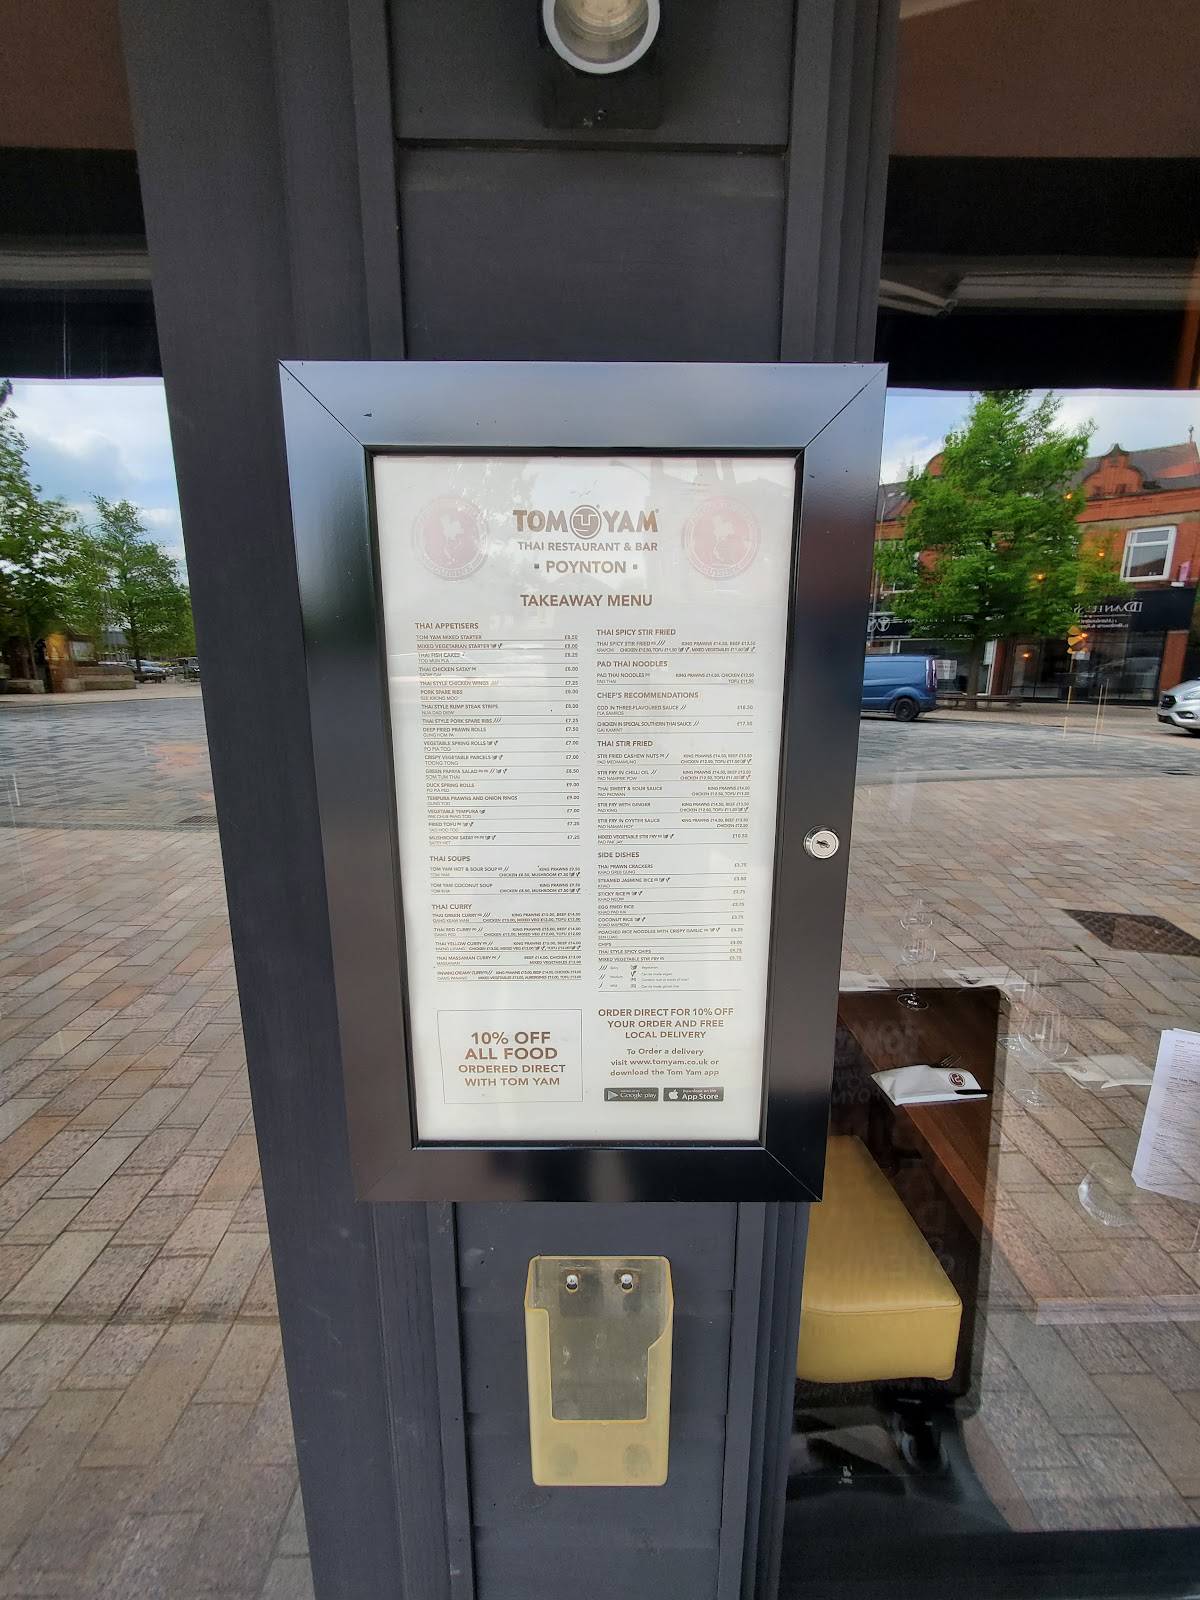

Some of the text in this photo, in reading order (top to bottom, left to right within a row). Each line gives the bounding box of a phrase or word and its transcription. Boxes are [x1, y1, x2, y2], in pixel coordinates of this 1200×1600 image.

[512, 510, 658, 534] TOM YAM
[518, 541, 658, 552] THAI RESTAURANT & BAR
[546, 561, 626, 574] POYNTON
[520, 595, 653, 607] TAKEAWAY MENU
[598, 1008, 734, 1017] ORDER DIRECT FOR 10% OFF
[607, 1020, 724, 1028] YOUR ORDER AND FREE
[471, 1032, 551, 1045] 10% OFF
[625, 1031, 707, 1039] LOCAL DELIVERY
[464, 1048, 558, 1060] ALL FOOD
[672, 1048, 704, 1057] delivery
[458, 1064, 566, 1073] ORDERED DIRECT
[464, 1077, 560, 1087] WITH TOM YAM
